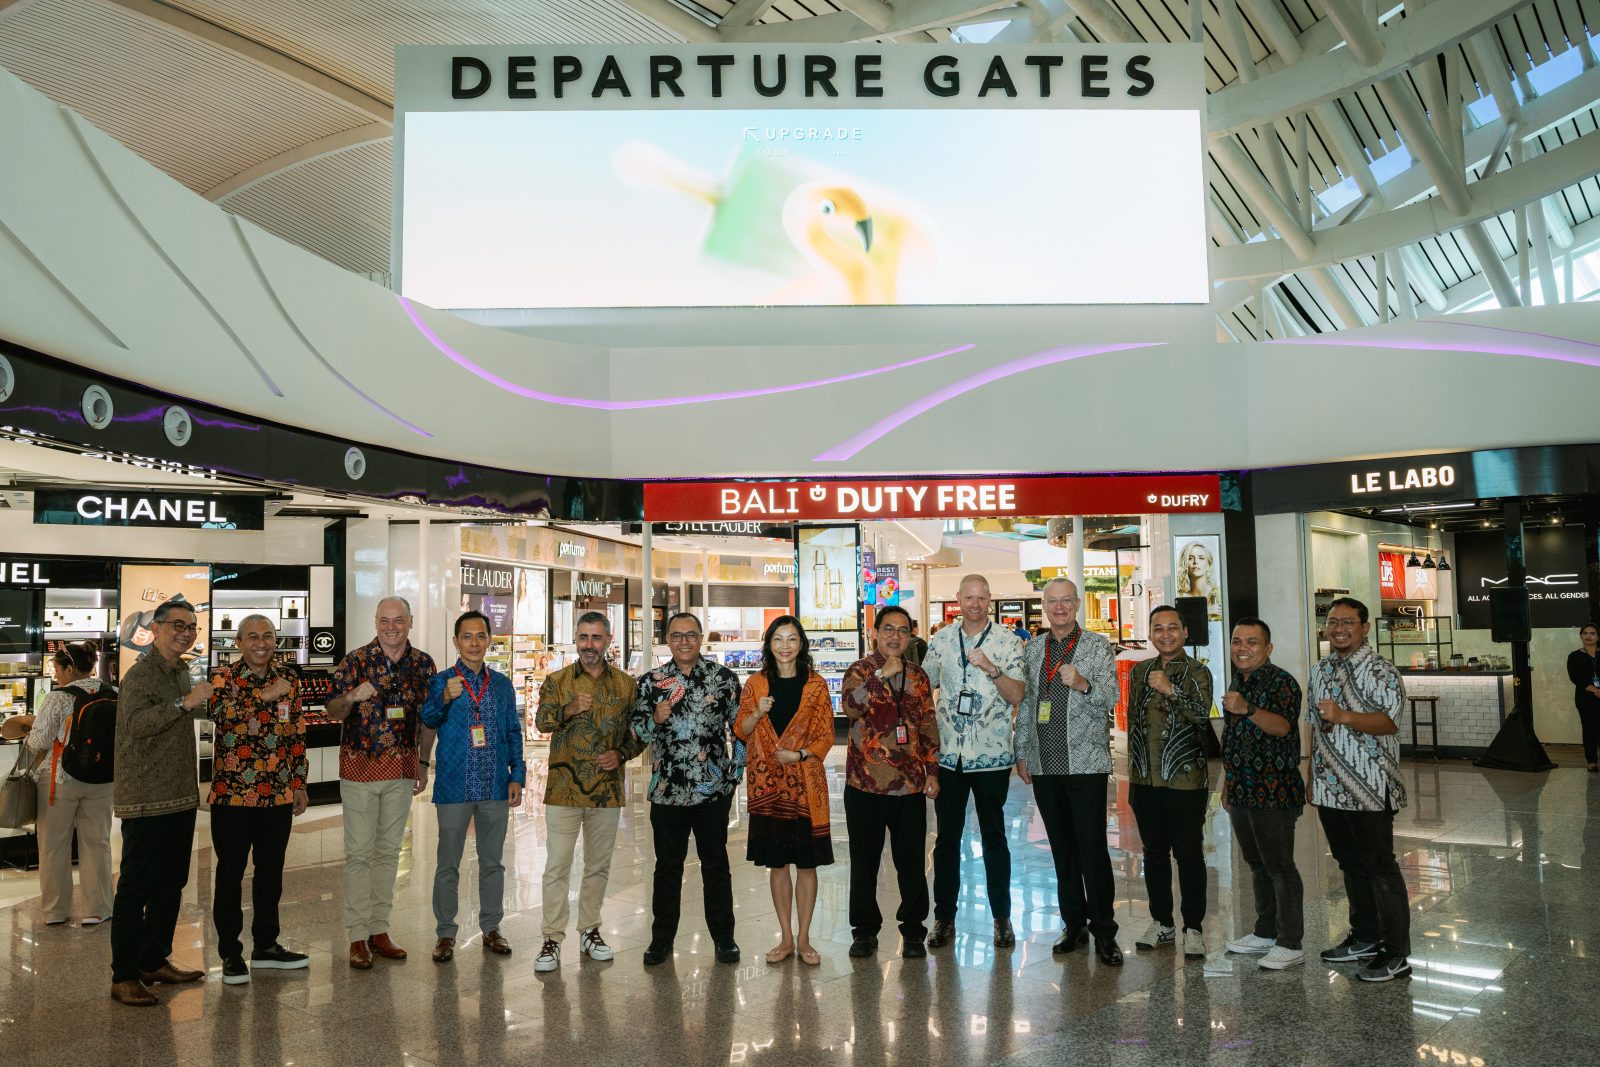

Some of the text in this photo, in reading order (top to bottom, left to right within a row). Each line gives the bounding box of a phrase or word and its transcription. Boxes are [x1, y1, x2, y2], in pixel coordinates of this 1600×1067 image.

[451, 54, 1155, 99] DEPARTURE GATES
[765, 127, 863, 141] UPGRADE
[1351, 465, 1455, 494] LE LABO
[76, 495, 227, 522] CHANEL
[720, 484, 1016, 514] BALI DUTY FREE
[1160, 494, 1209, 507] DUFRY
[559, 540, 586, 558] perfume
[477, 568, 513, 589] LAUDER
